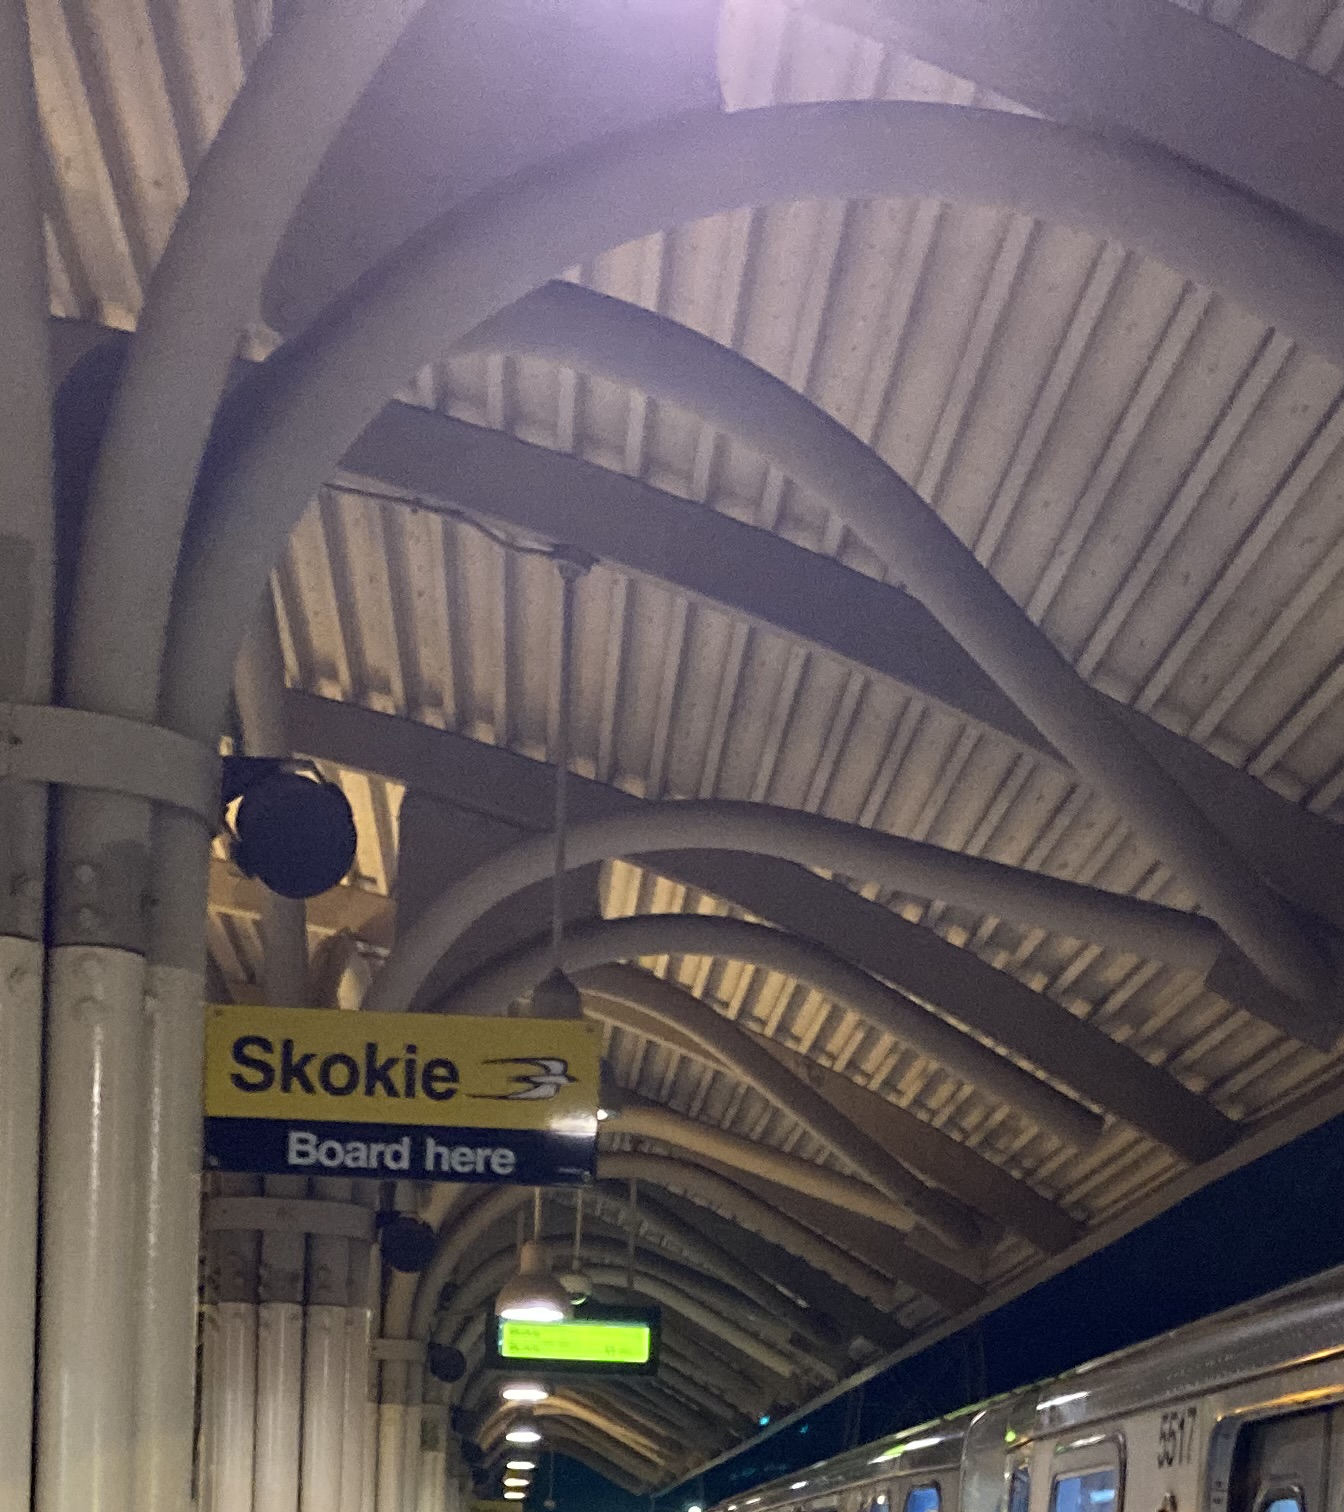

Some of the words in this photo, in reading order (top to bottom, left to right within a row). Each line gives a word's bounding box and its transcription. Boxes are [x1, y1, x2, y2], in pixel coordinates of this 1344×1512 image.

[229, 1034, 460, 1101] Skokie
[286, 1130, 411, 1170] Board
[425, 1137, 516, 1175] here
